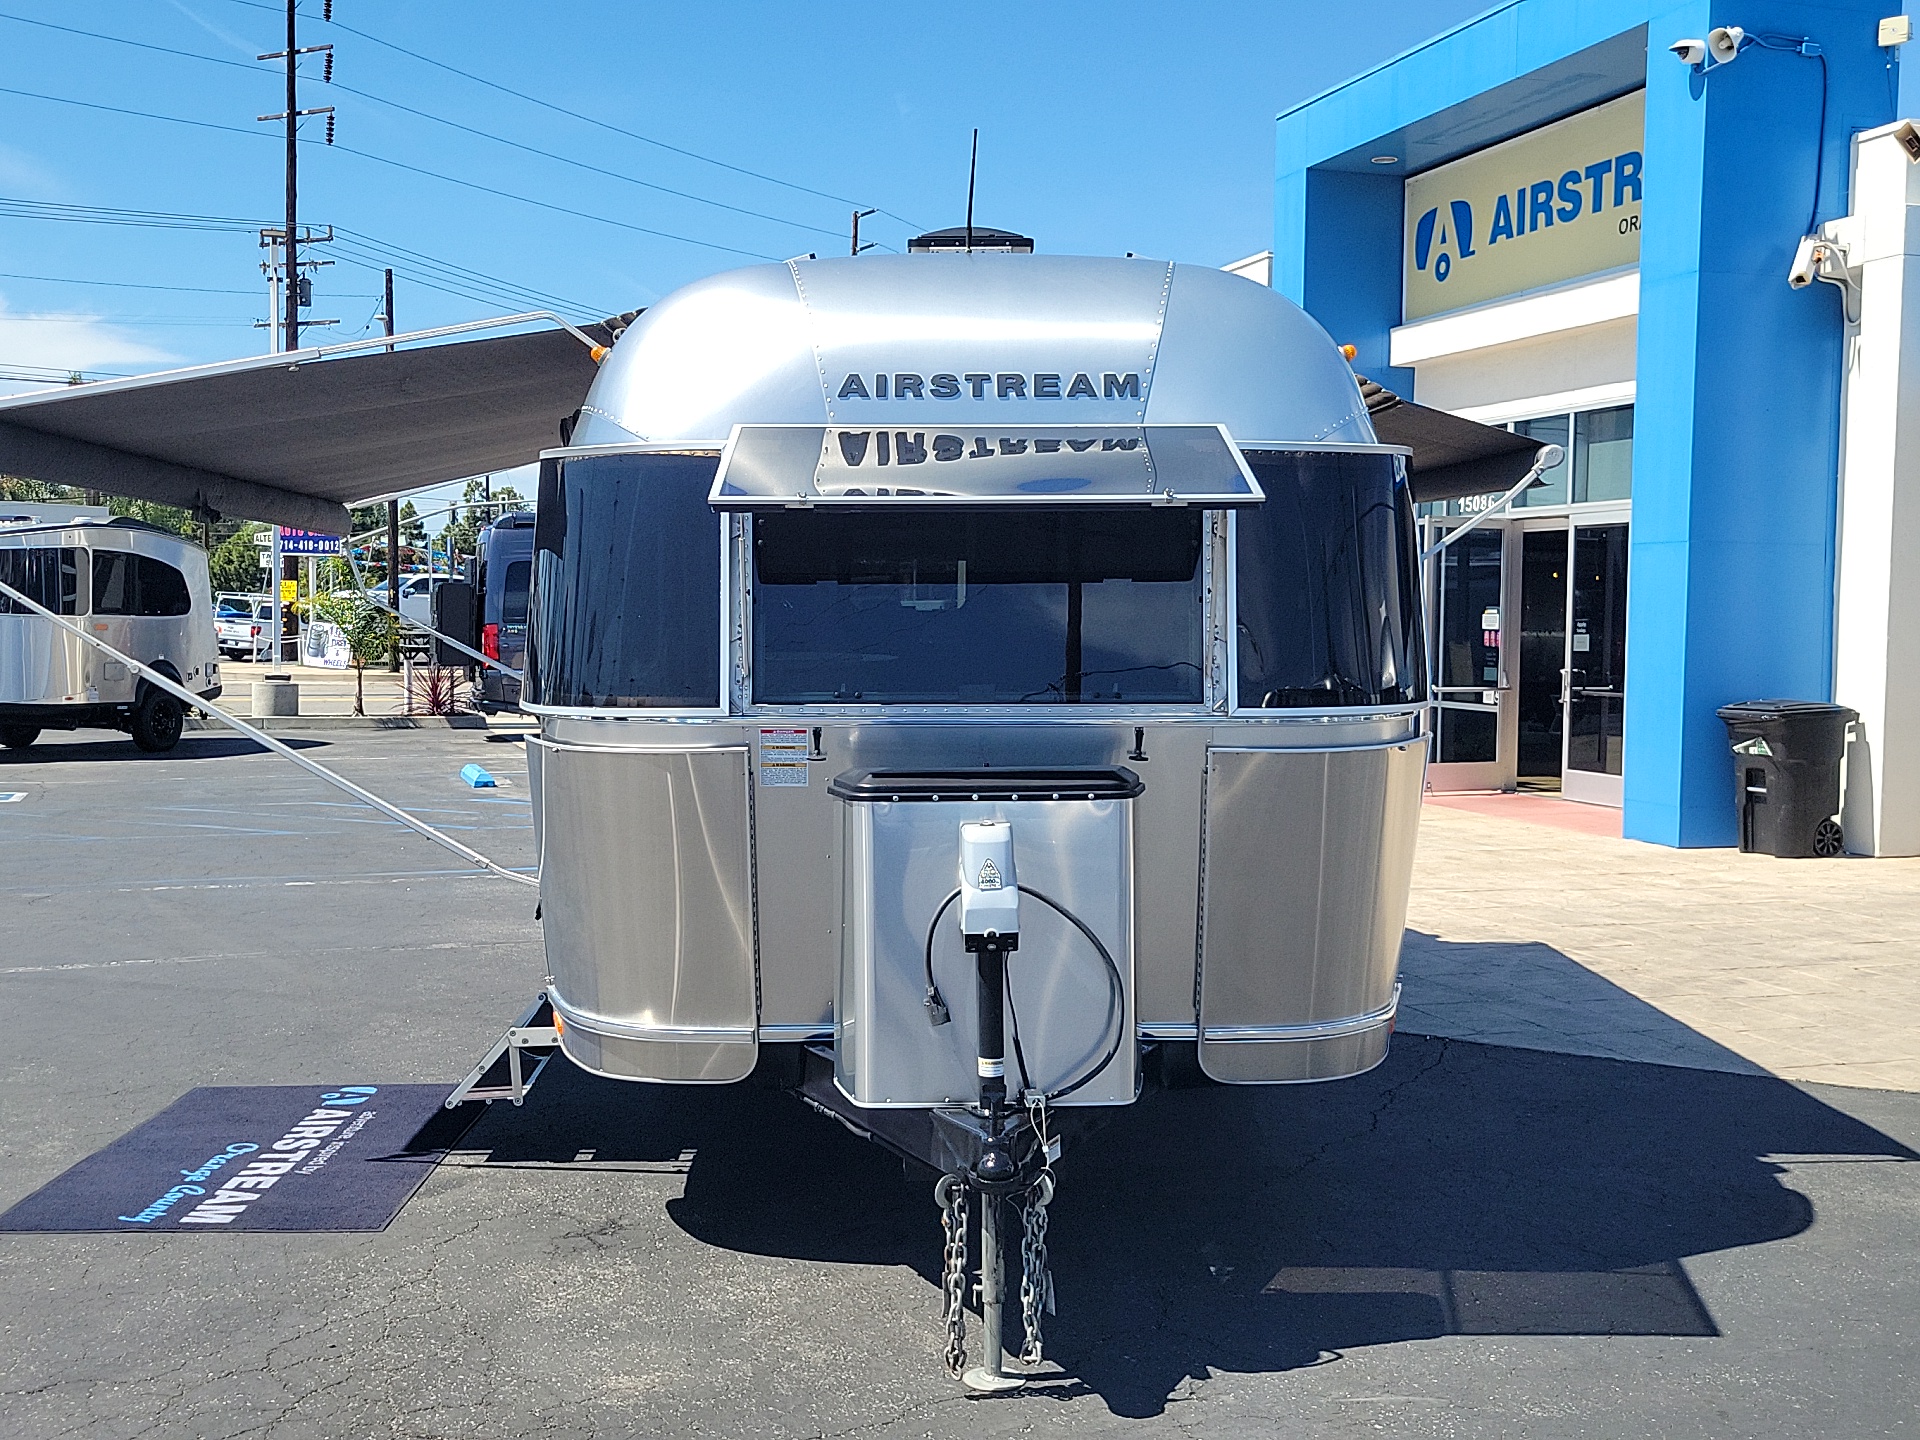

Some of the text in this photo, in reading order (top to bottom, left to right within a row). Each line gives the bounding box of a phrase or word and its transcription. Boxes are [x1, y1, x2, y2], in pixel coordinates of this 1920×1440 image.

[1488, 151, 1643, 245] AIRSTR
[837, 372, 1140, 400] AIRSTREAM
[118, 1142, 260, 1223] Orange County
[179, 1108, 354, 1224] AIRSTREAM
